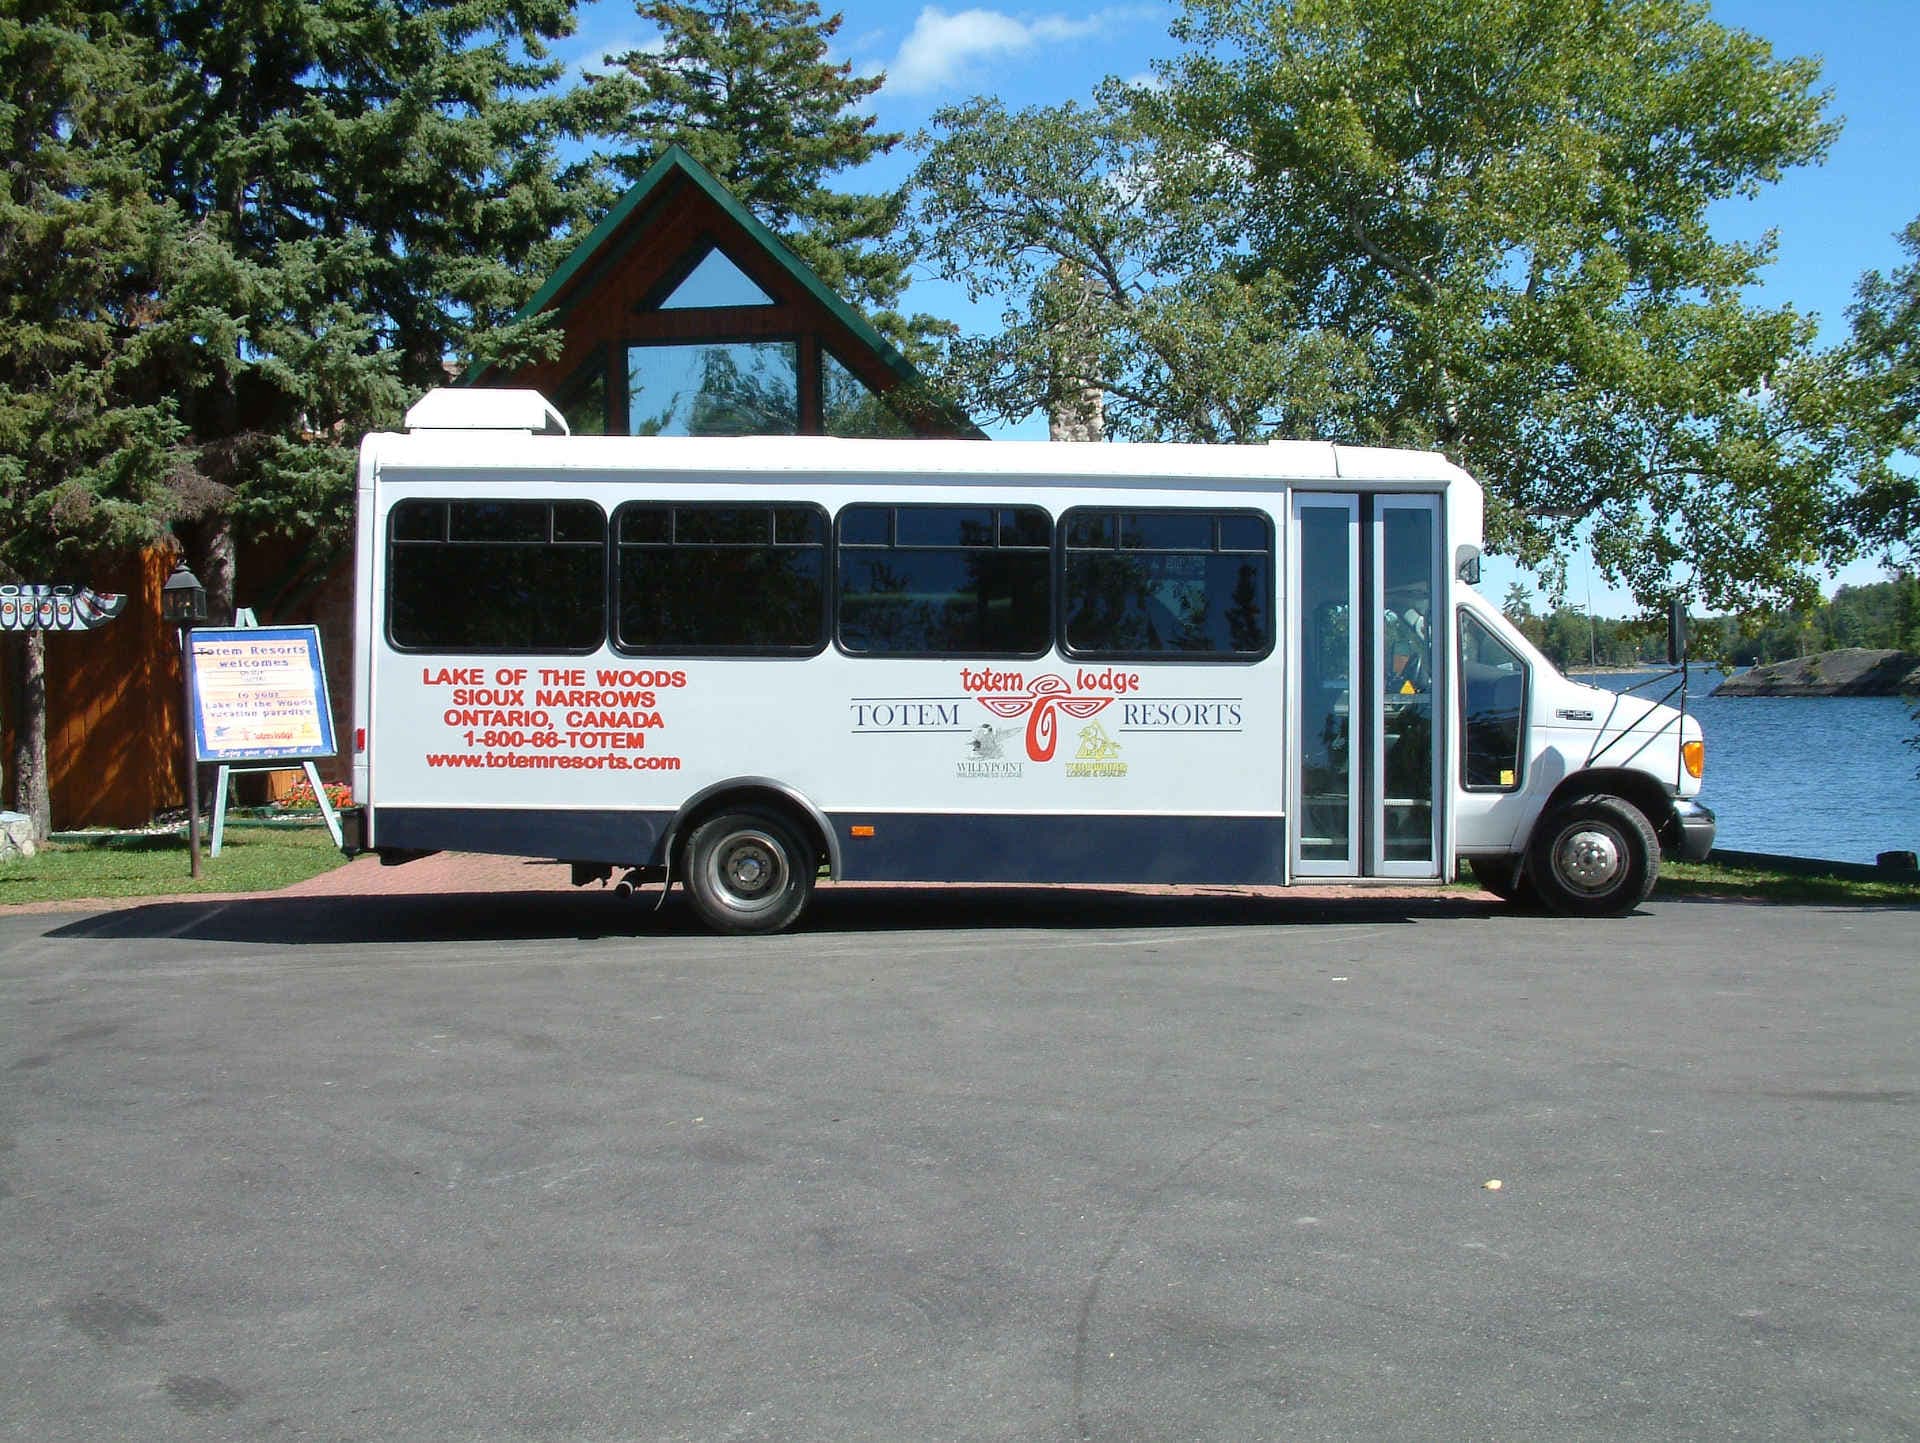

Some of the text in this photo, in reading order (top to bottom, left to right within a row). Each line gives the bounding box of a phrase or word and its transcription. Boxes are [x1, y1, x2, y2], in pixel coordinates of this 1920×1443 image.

[198, 646, 306, 656] Totem Resorts
[219, 659, 289, 668] welcomes
[423, 668, 687, 687] LAKE OF THE WOODS
[960, 667, 1140, 694] totem lodge
[453, 689, 656, 708] SIOUX NARROWS
[444, 710, 664, 730] ONTARIO, CANADA
[850, 703, 1241, 726] TOTEM RESORTS
[463, 731, 645, 749] 1-800-66-TOTEM
[427, 752, 681, 770] www.totemresorts.com
